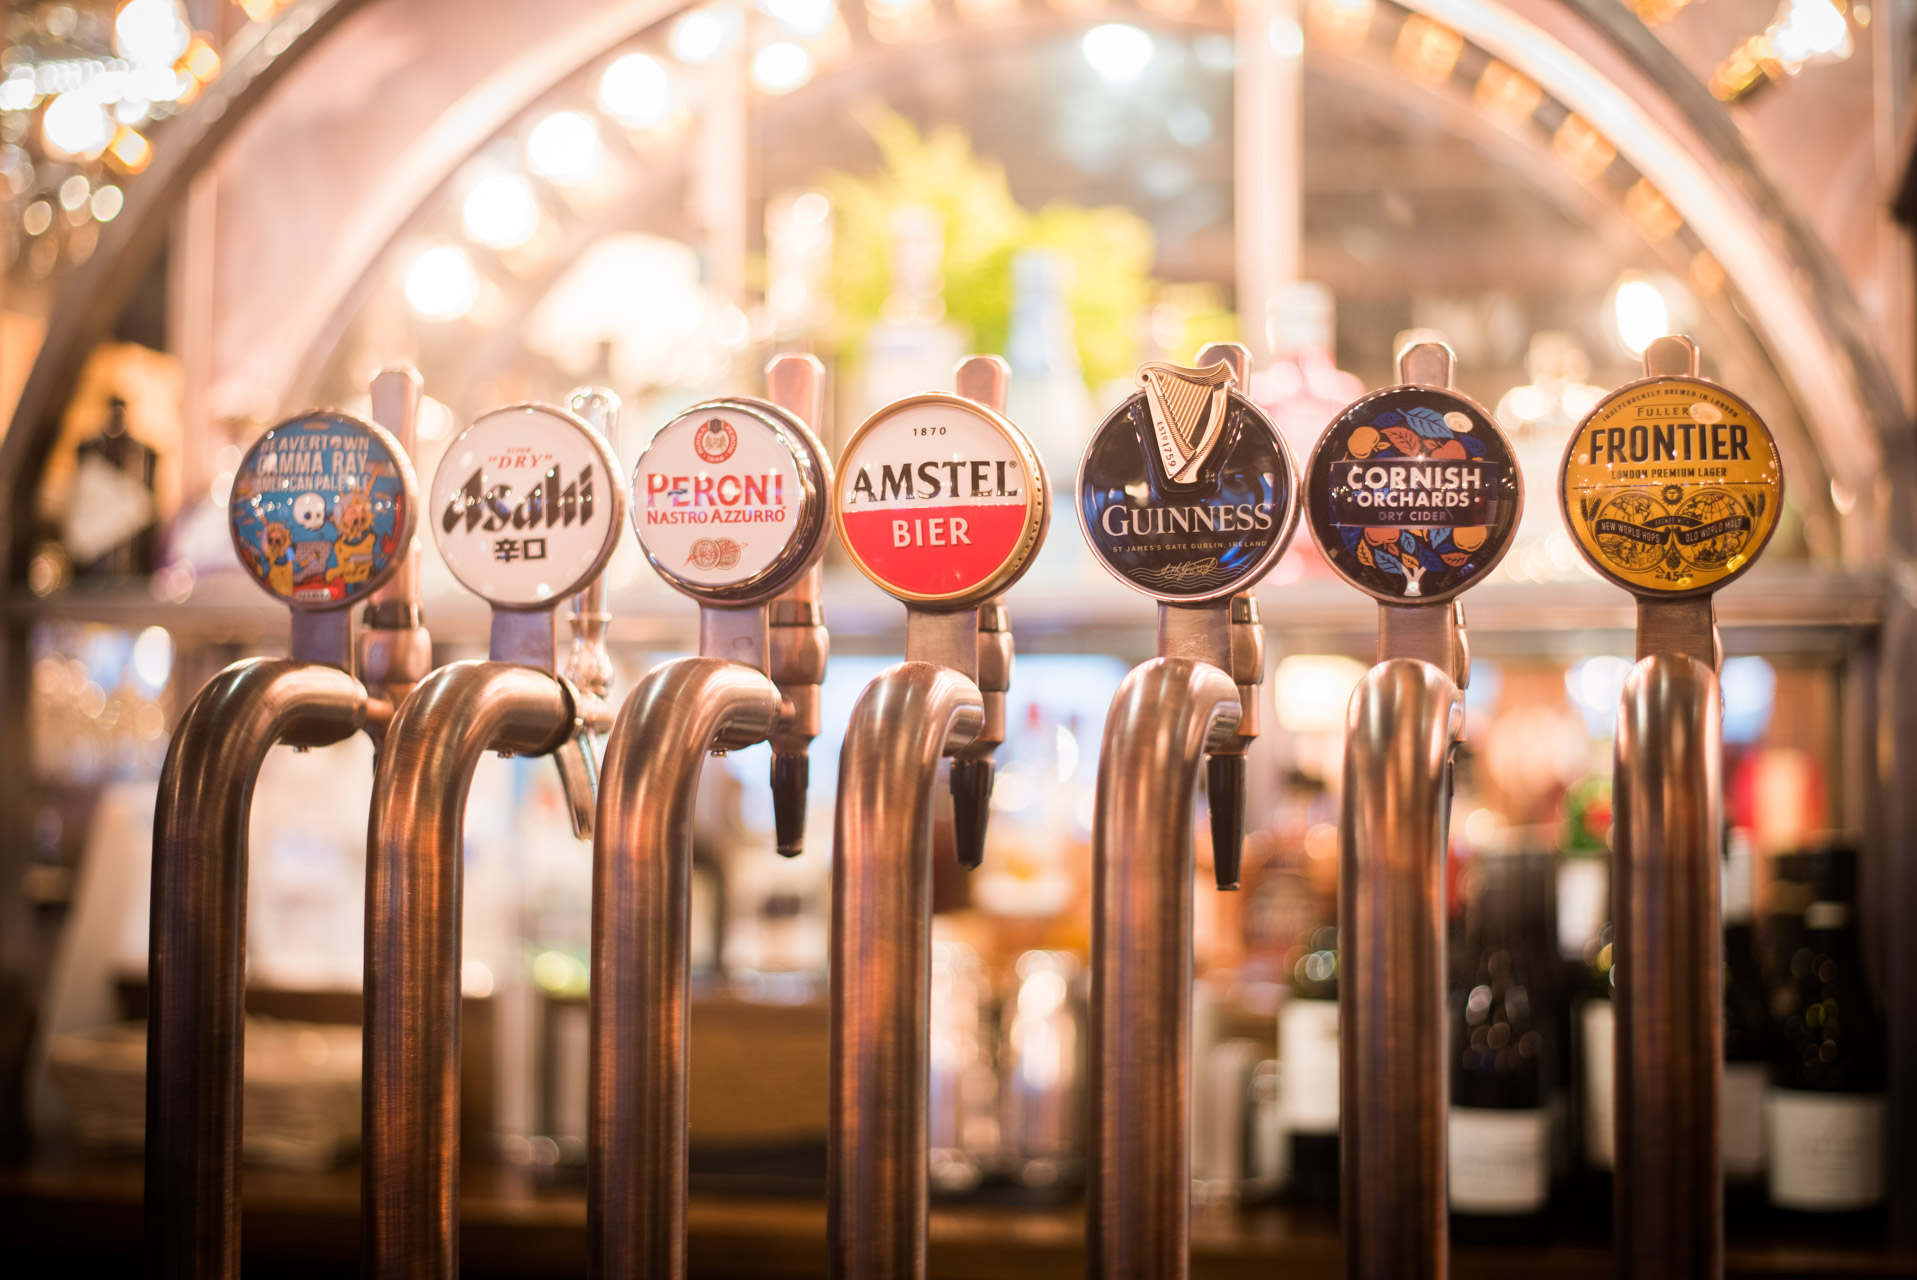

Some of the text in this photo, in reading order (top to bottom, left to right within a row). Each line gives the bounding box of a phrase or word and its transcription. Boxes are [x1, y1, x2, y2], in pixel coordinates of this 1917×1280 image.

[1664, 388, 1696, 397] BREWED
[1699, 393, 1708, 401] IN
[1710, 397, 1739, 419] LONDON
[913, 426, 947, 437] 1870
[1162, 442, 1177, 467] 1759
[1589, 423, 1751, 465] FRONTIER
[331, 451, 369, 474] RAY
[1611, 467, 1727, 480] LONDON PREMIUM LAGER
[314, 474, 344, 492] PALE
[1347, 467, 1480, 489] CORNISH
[442, 463, 593, 534] Asahi
[647, 473, 783, 507] PERONI
[1357, 491, 1470, 507] ORCHARDS
[647, 510, 708, 525] NASTRO
[1102, 504, 1273, 536] GUINNESS
[1378, 511, 1446, 521] DRY CIDER
[892, 517, 971, 547] BIER
[1601, 521, 1661, 543] NEW WORLD HOPS
[1685, 517, 1743, 543] OLD WORLD MALT
[495, 538, 546, 562] 辛口
